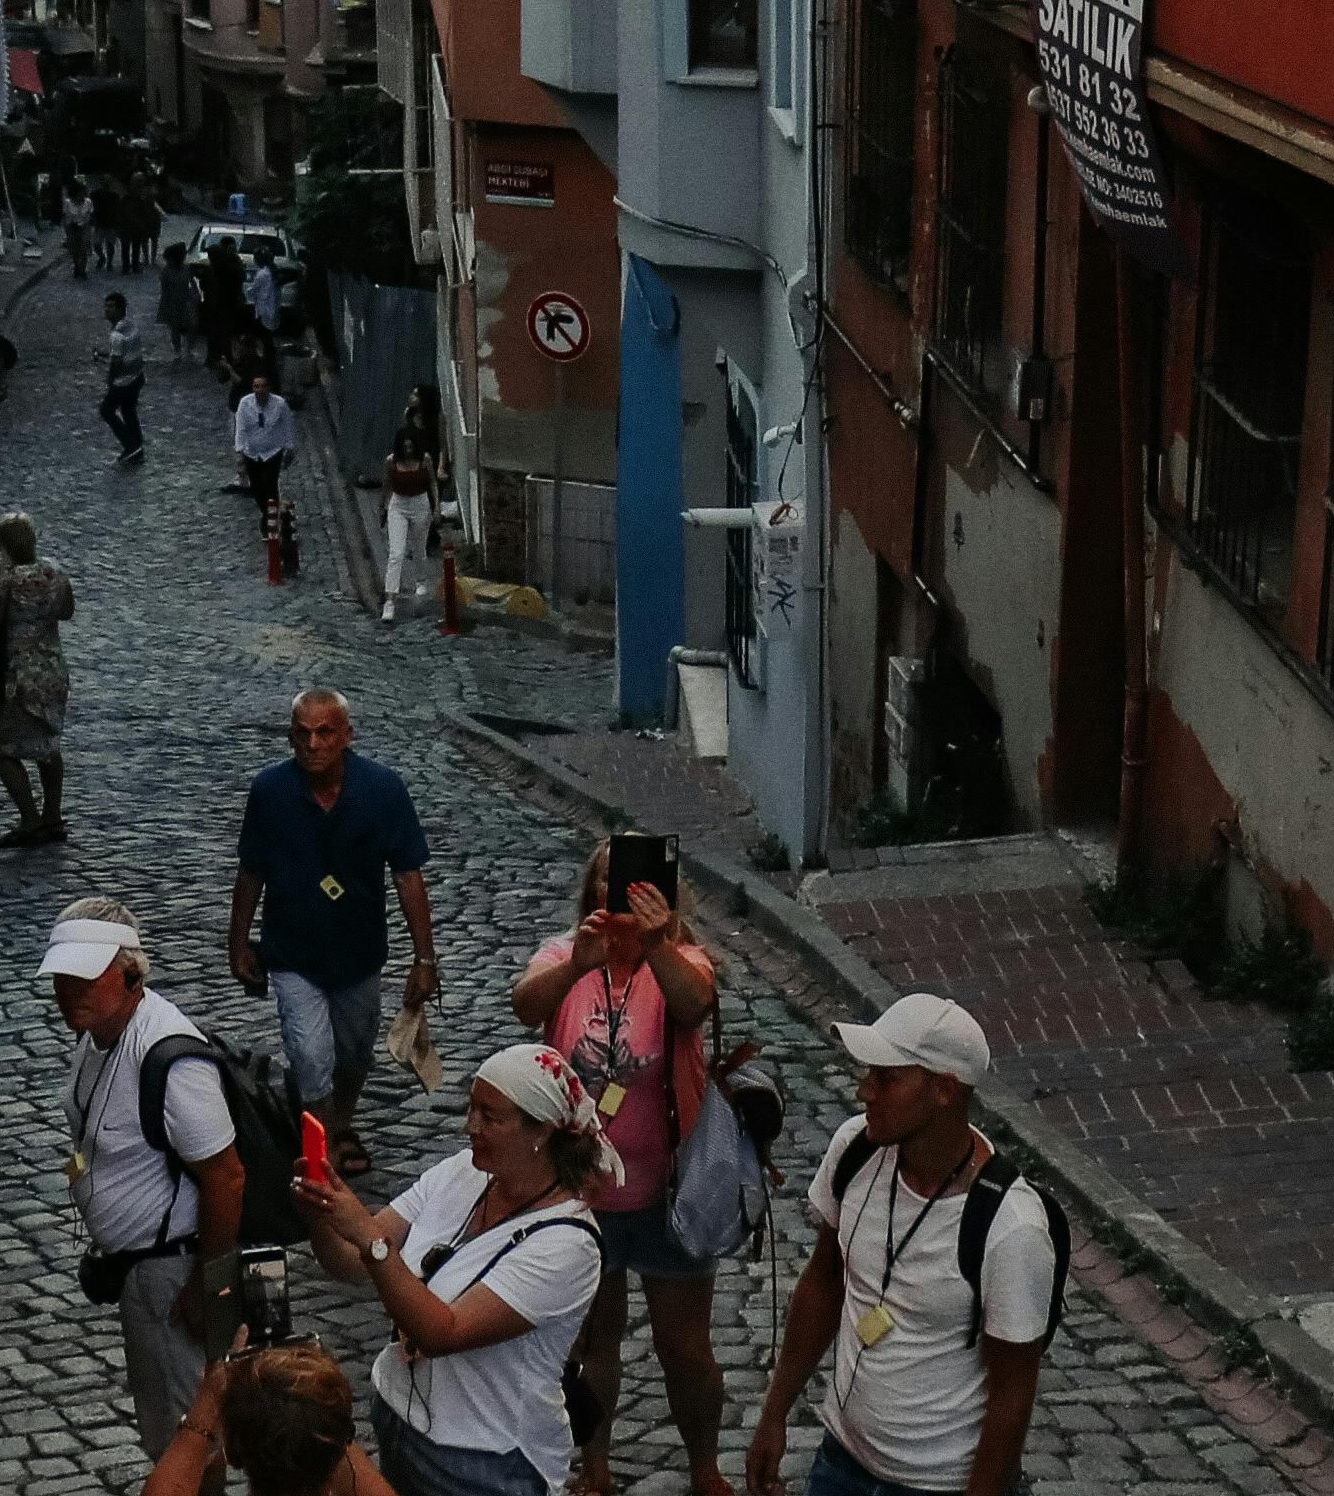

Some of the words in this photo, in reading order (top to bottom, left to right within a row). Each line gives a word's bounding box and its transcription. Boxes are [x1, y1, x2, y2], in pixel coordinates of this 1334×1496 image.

[1038, 38, 1071, 87] 531
[1079, 63, 1101, 105] 81
[1109, 80, 1141, 122] 32
[1074, 100, 1099, 140] 552
[1101, 116, 1121, 151] 36
[1123, 126, 1149, 158] 33
[1113, 182, 1163, 209] 3402516
